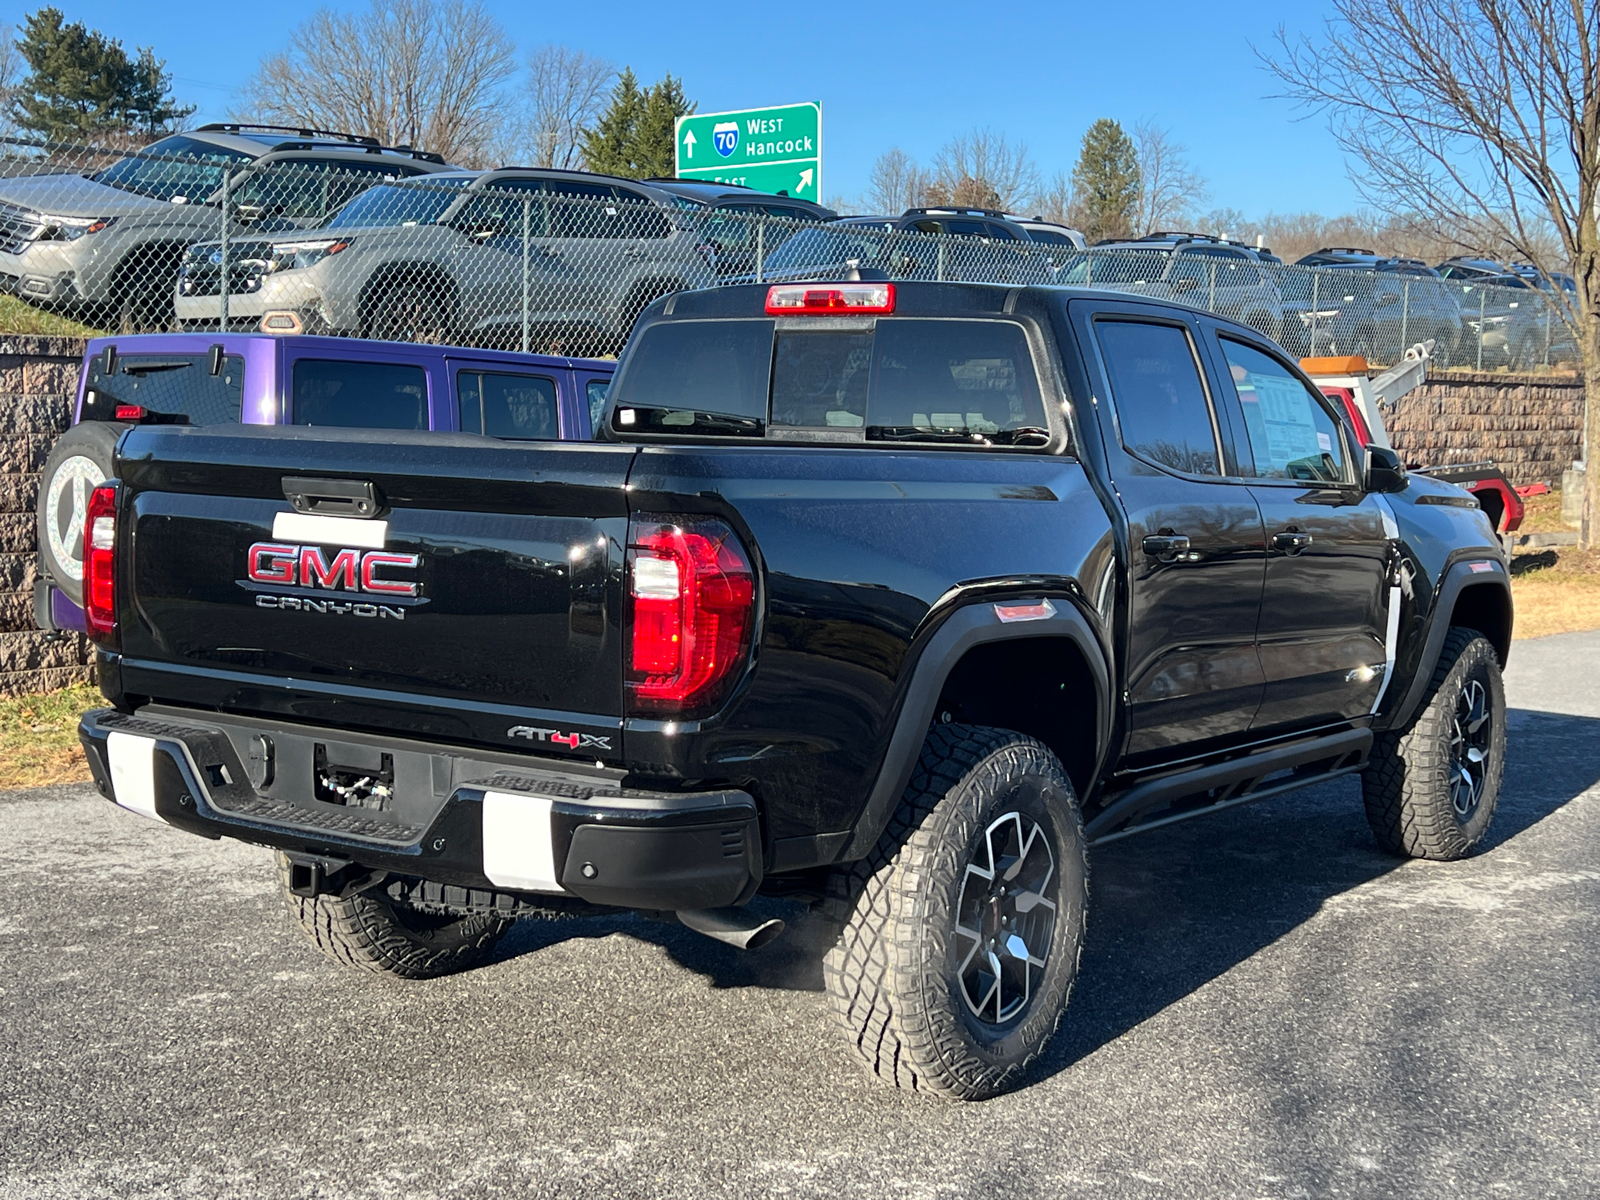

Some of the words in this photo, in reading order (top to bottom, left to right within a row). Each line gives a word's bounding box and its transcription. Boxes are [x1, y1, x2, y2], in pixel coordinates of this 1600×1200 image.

[746, 118, 784, 135] WEST
[716, 132, 736, 150] 70
[746, 136, 813, 156] Hancock
[248, 541, 420, 597] GMC
[255, 594, 407, 621] CANYON
[507, 725, 612, 750] AT4X
